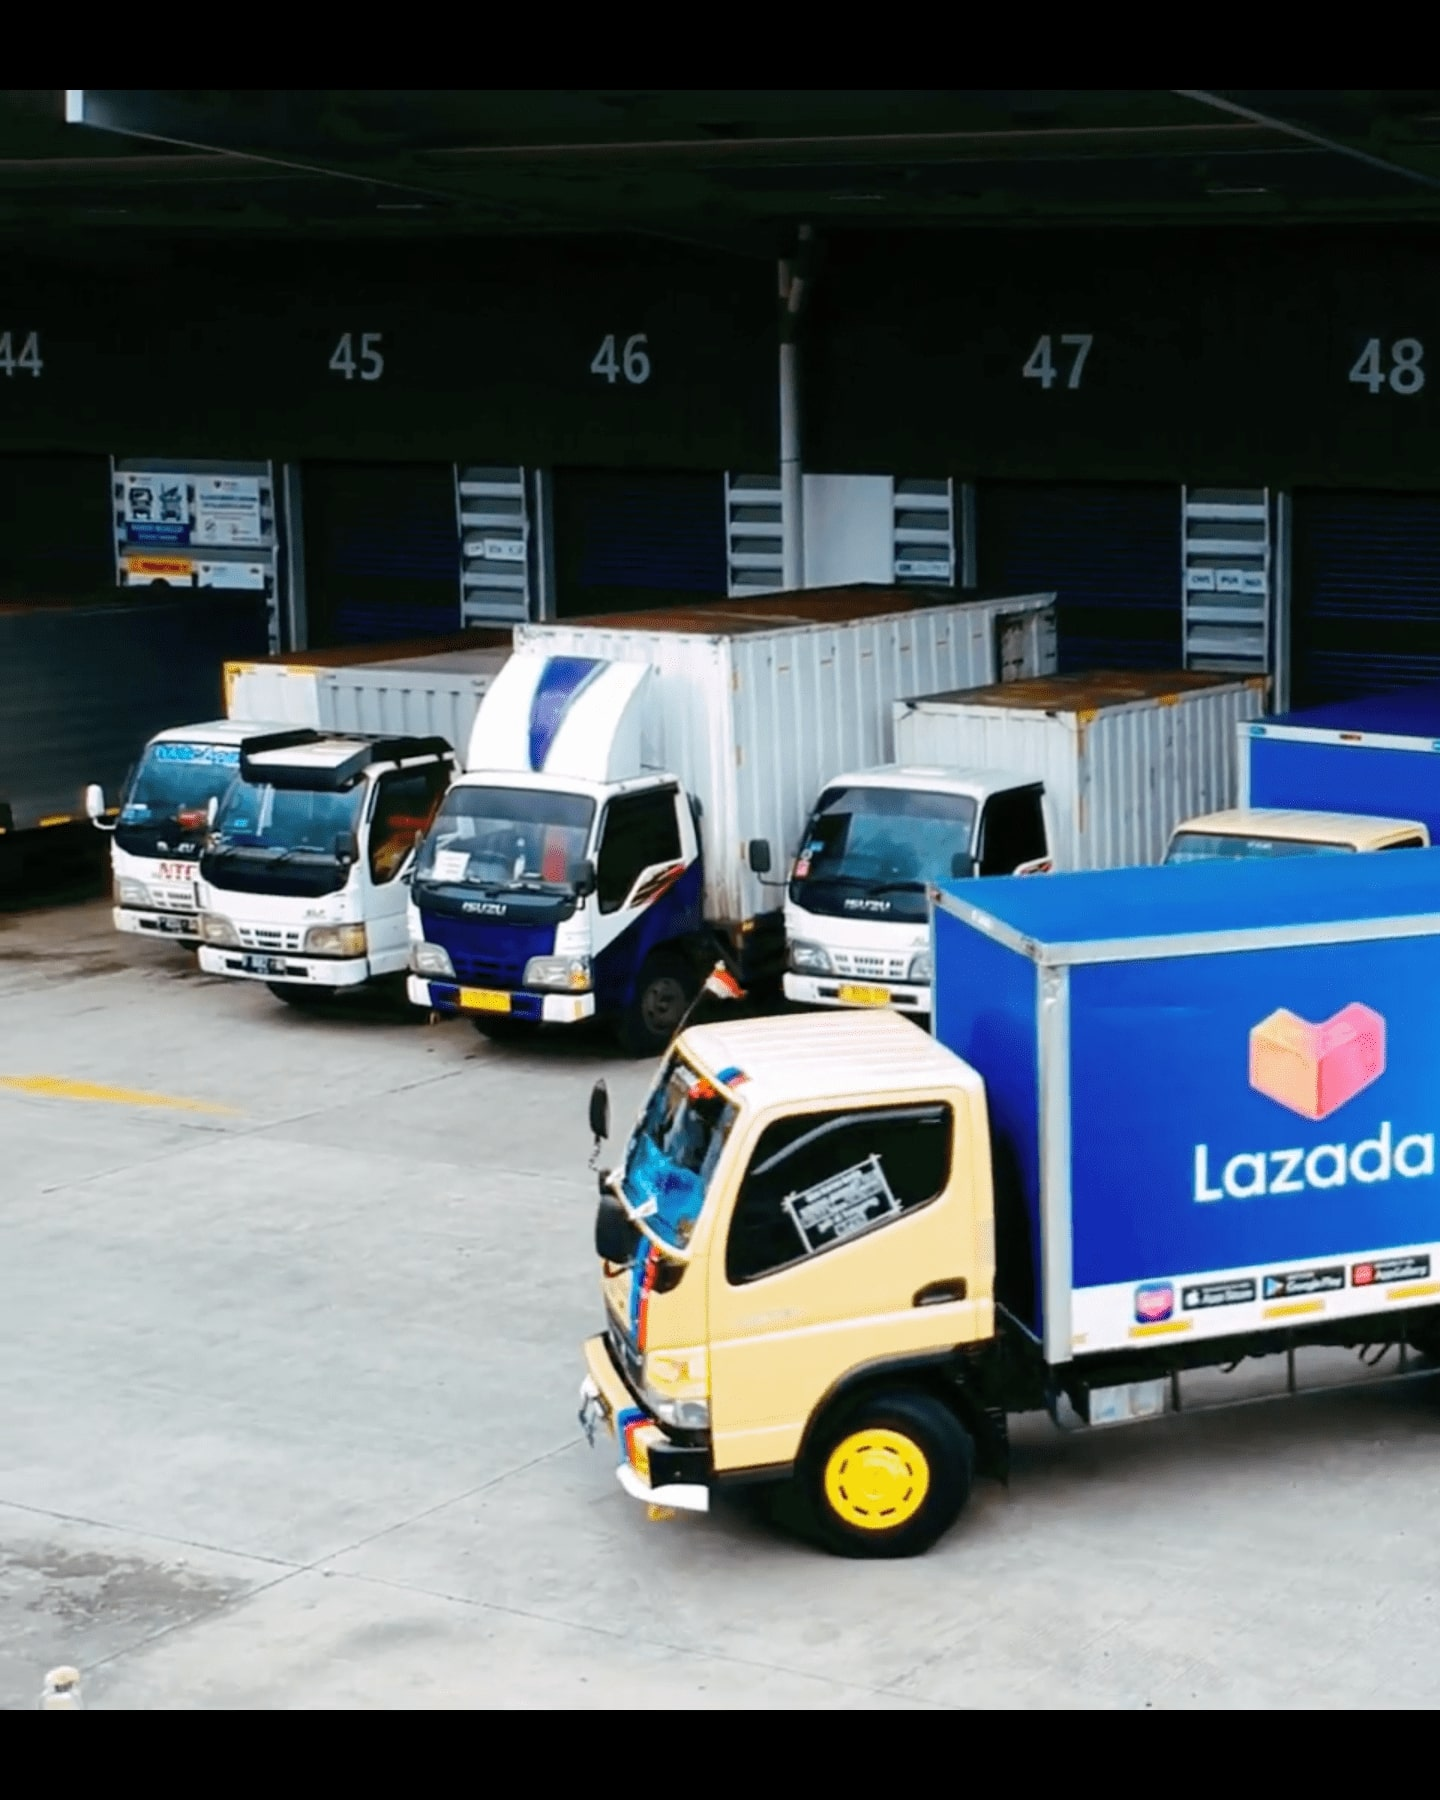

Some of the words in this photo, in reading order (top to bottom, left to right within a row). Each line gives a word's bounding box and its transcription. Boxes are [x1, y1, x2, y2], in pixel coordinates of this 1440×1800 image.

[329, 333, 384, 380] 45
[590, 334, 650, 384] 46
[1023, 335, 1092, 389] 47
[1349, 338, 1425, 394] 48
[461, 901, 507, 916] ISUZU
[844, 898, 892, 912] ISUZU
[1193, 1121, 1436, 1203] Lazada
